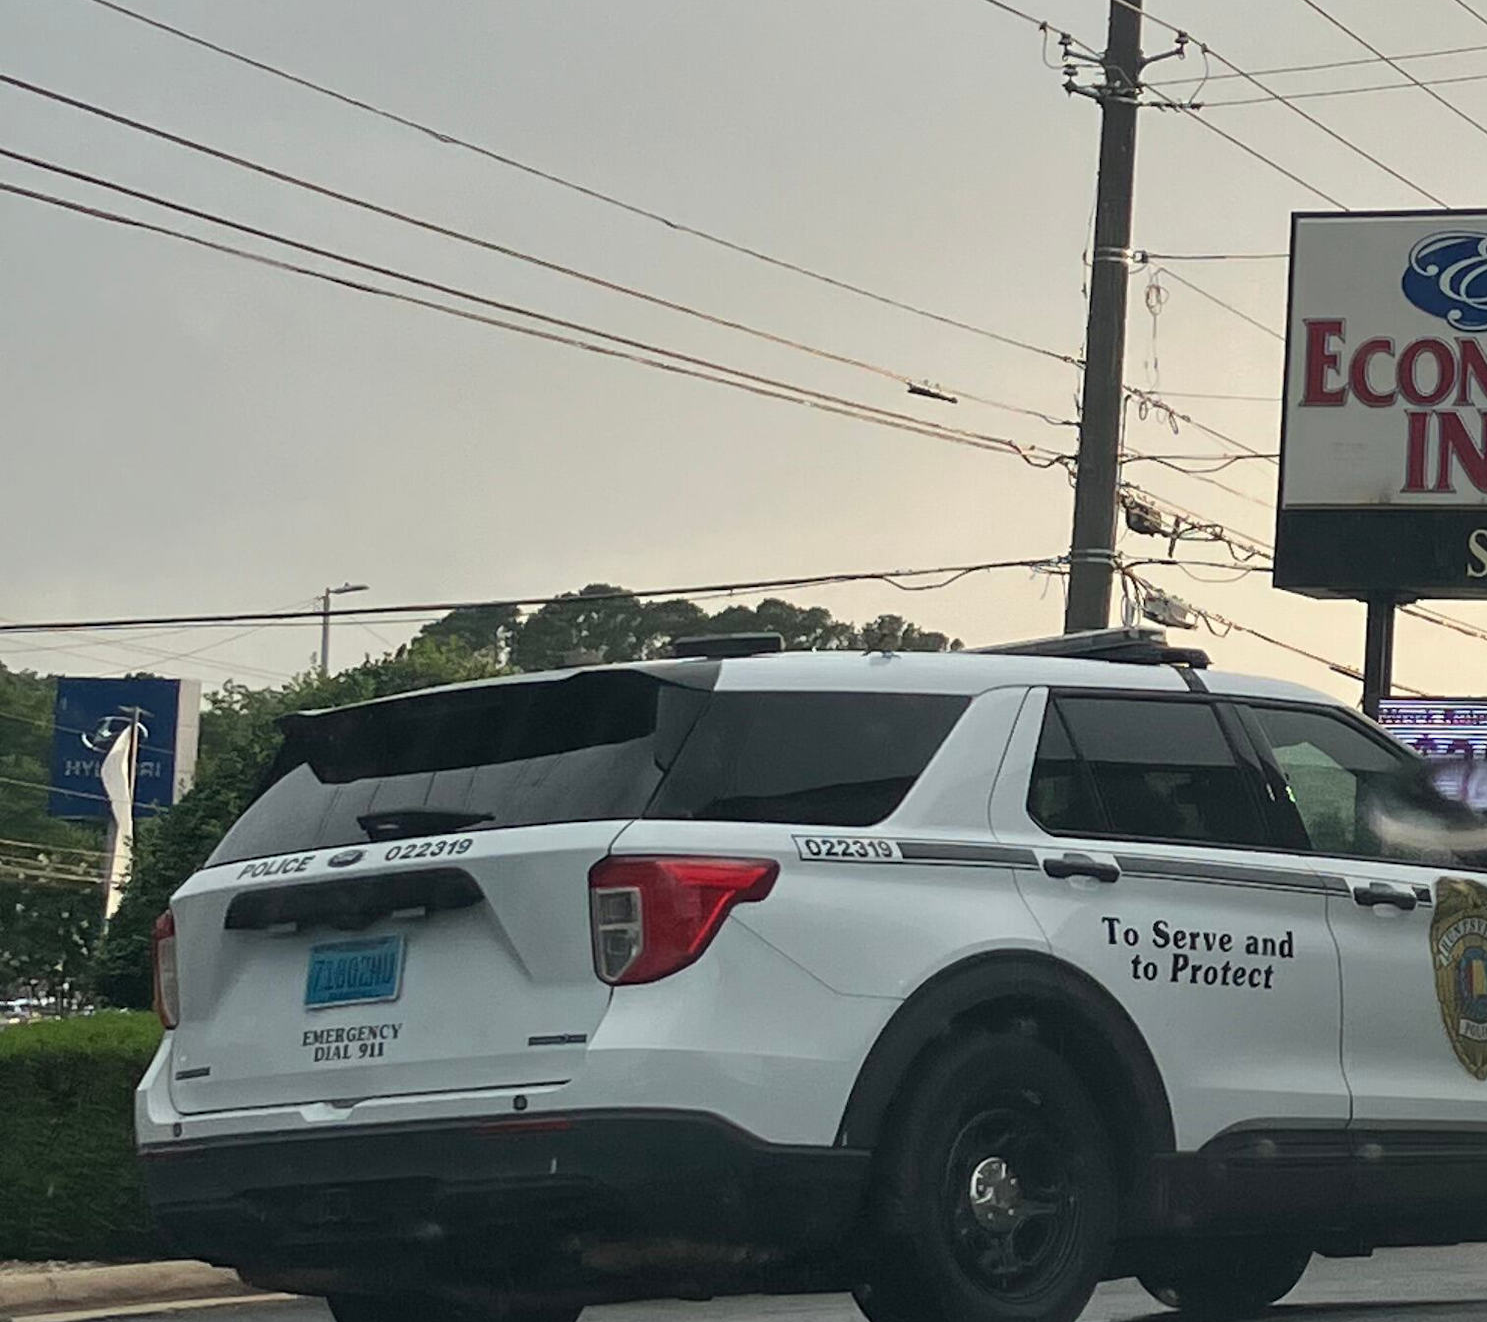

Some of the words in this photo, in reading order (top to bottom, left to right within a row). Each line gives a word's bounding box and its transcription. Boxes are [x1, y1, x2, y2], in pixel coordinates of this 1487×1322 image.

[237, 856, 315, 879] POLICE
[384, 838, 474, 862] 022319
[805, 839, 893, 858] 022319
[1102, 917, 1139, 946] To
[1153, 920, 1233, 953] Serve
[1246, 931, 1294, 959] and
[1132, 955, 1158, 981] to
[1170, 953, 1275, 989] Protect
[302, 1023, 402, 1046] EMERGENCY
[314, 1044, 352, 1062] DIAL
[358, 1042, 384, 1059] 911
